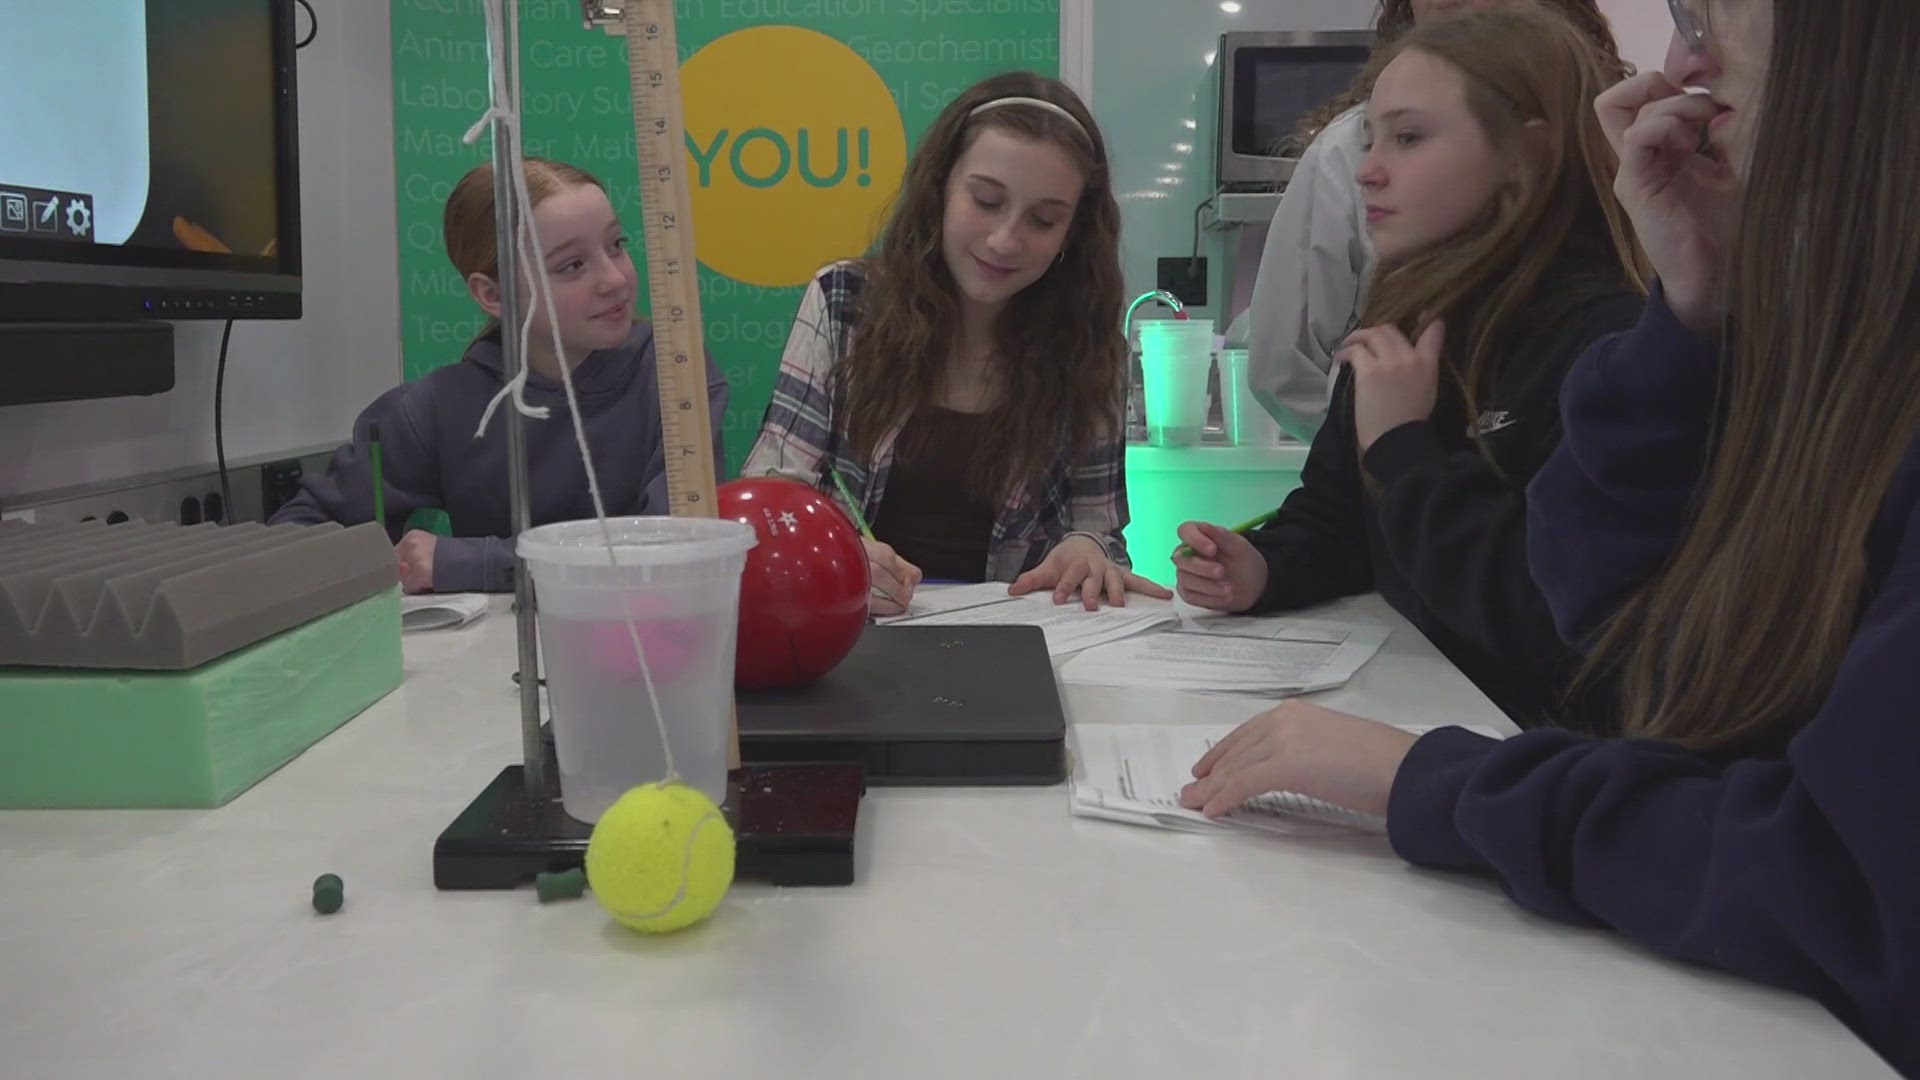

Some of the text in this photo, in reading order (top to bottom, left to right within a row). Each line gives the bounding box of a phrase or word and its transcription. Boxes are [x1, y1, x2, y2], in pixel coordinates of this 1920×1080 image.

[645, 24, 659, 41] 16
[529, 39, 607, 69] Care
[649, 72, 663, 89] 15
[654, 120, 667, 136] 14
[684, 126, 872, 189] YOU!
[658, 166, 672, 184] 13
[662, 214, 676, 231] 12
[666, 260, 680, 276] 11
[670, 305, 684, 324] 10
[675, 354, 688, 365] 9
[679, 401, 692, 411] 8
